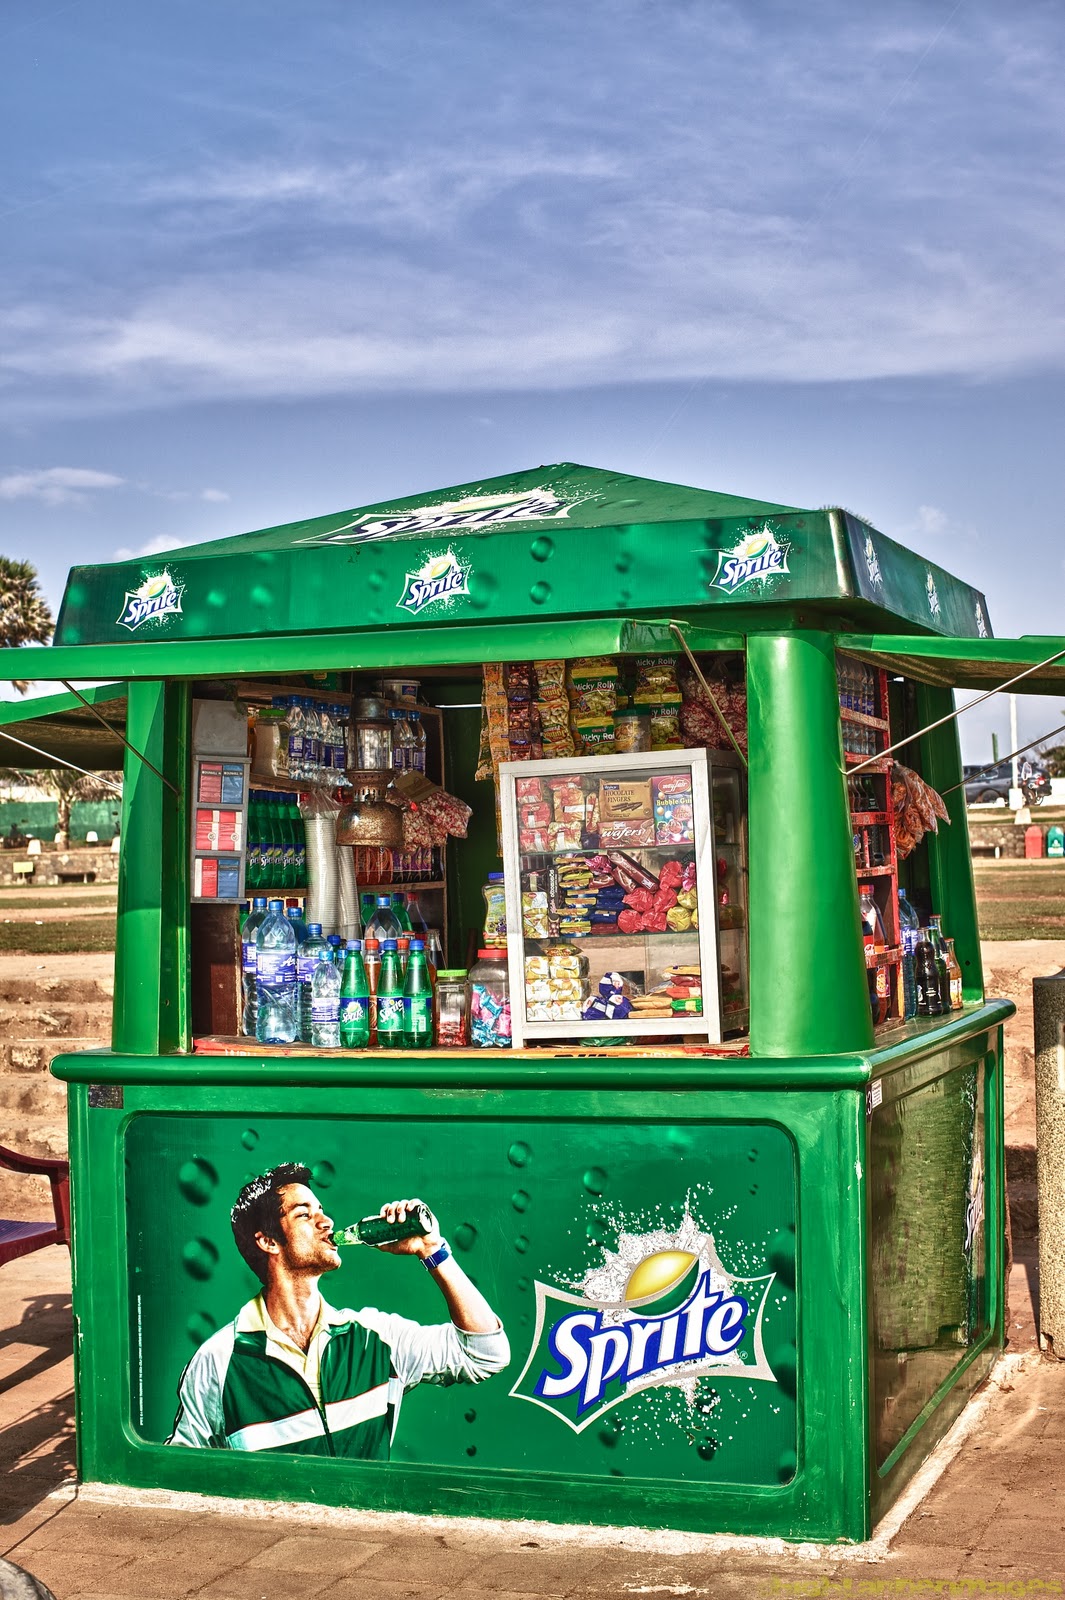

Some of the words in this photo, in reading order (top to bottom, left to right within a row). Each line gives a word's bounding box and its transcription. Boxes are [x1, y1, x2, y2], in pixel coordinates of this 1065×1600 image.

[322, 497, 566, 542] Sprite
[717, 544, 782, 587] Sprite
[404, 566, 464, 608] Sprite
[123, 586, 178, 624] Sprite
[597, 680, 616, 690] Rolly
[660, 707, 679, 717] Rolly
[604, 789, 635, 797] HOCOLATE
[656, 798, 679, 807] Bubble
[602, 826, 642, 840] wafers
[341, 1009, 364, 1024] Sprite
[380, 999, 404, 1024] Sprite
[533, 1268, 749, 1418] Sprite
